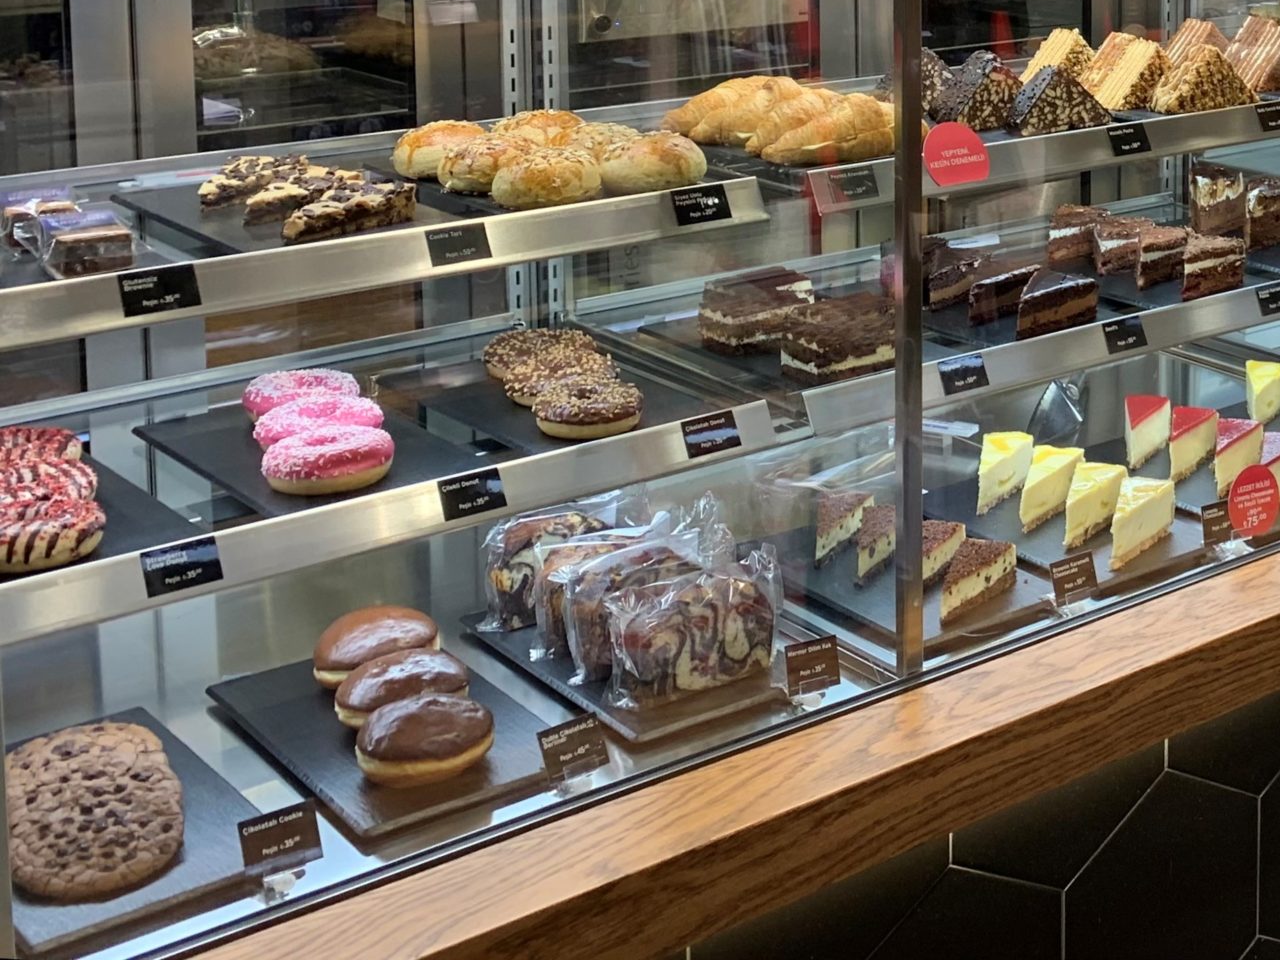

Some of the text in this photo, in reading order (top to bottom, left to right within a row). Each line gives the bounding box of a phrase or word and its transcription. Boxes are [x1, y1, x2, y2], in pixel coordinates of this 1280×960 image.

[929, 158, 950, 169] KESİN
[460, 478, 480, 488] Donut
[278, 810, 304, 824] Cookie
